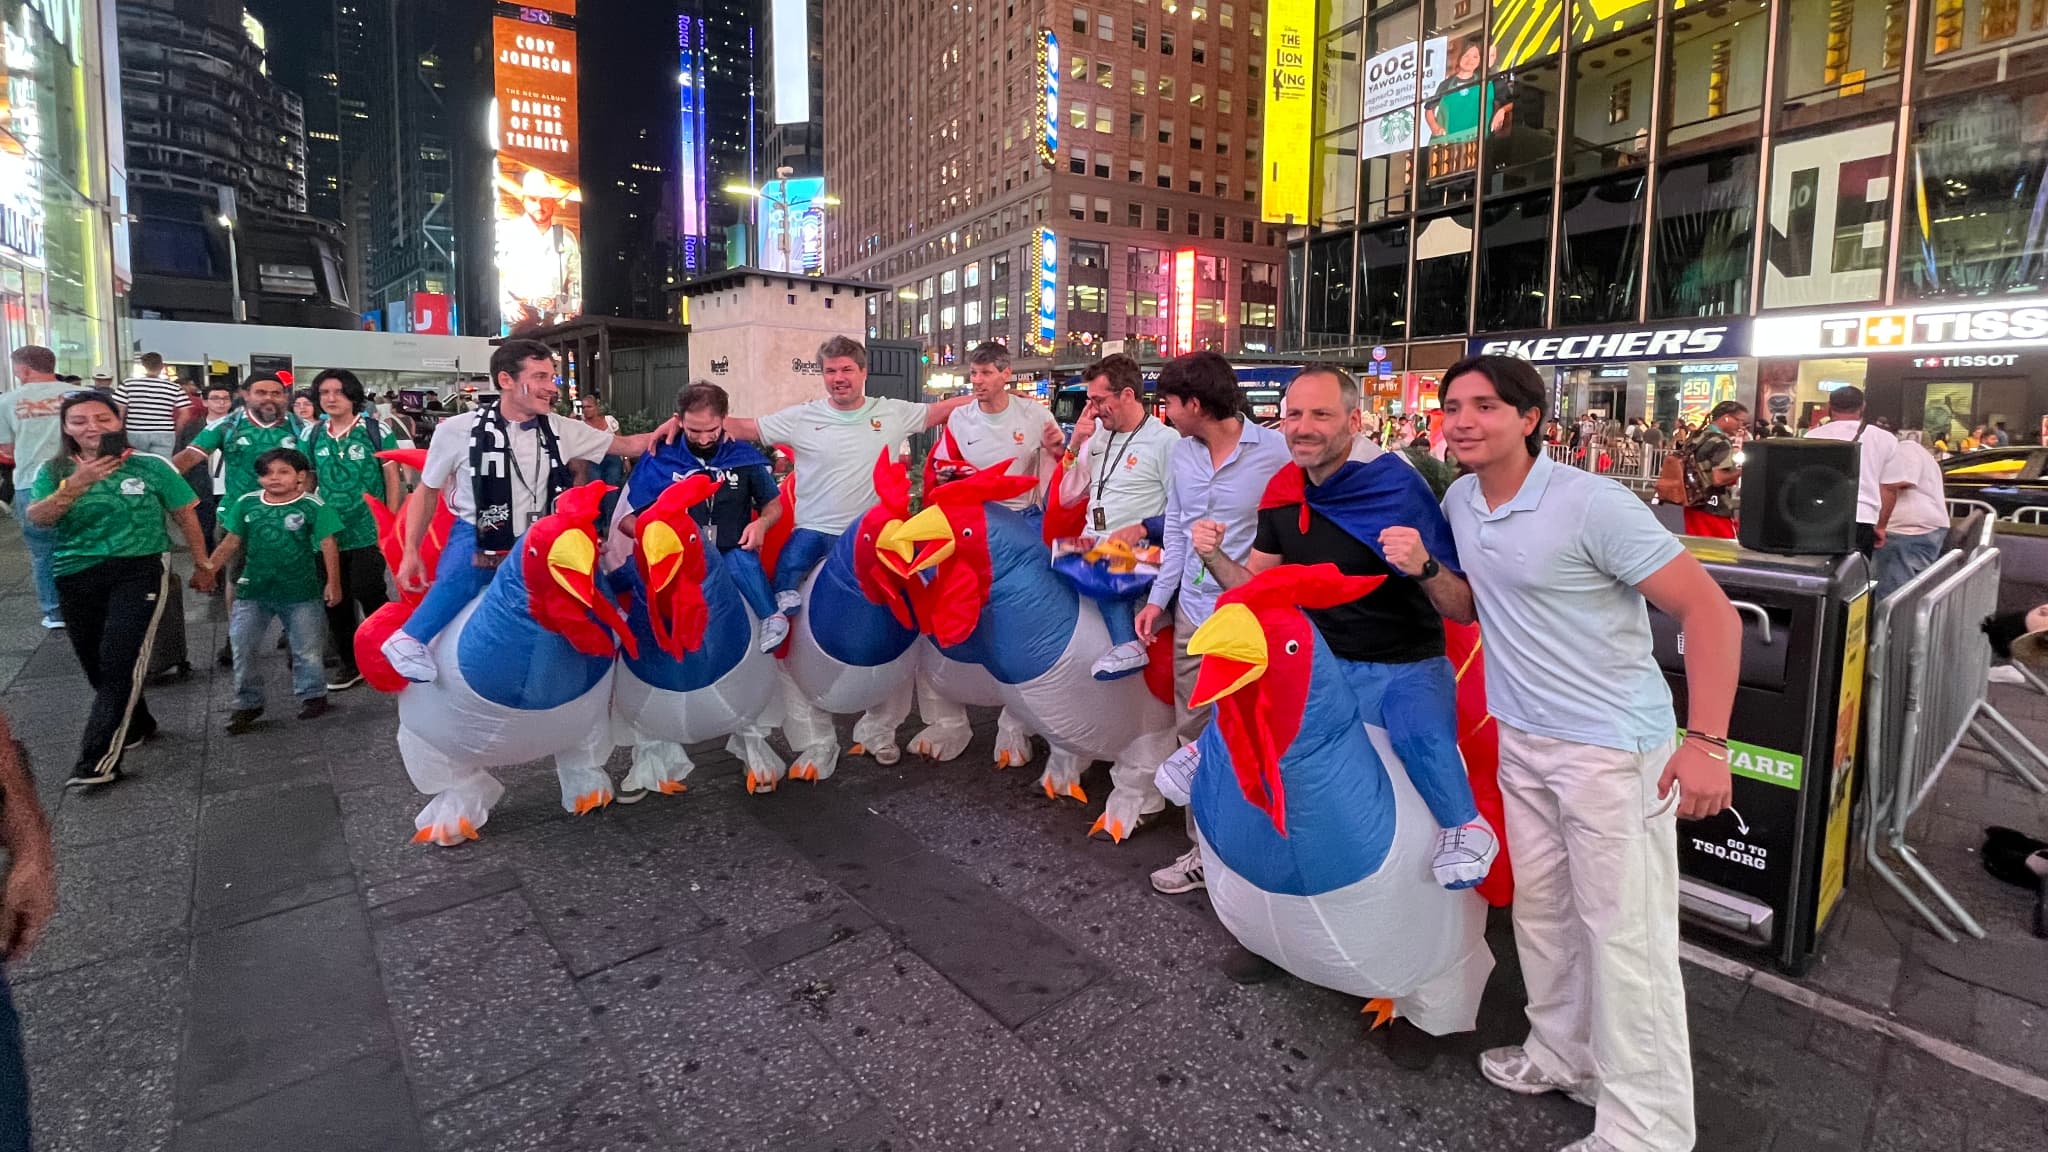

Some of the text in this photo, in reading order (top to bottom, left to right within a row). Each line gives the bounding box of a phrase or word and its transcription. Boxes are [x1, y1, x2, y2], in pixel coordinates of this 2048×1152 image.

[520, 7, 550, 25] 250
[516, 35, 555, 54] CODY
[1280, 34, 1300, 45] THE
[500, 49, 572, 75] JOHNSON
[1276, 48, 1303, 66] LION
[1273, 69, 1305, 90] KING
[506, 87, 520, 95] THE
[541, 94, 567, 102] ALBUM
[511, 98, 562, 119] BANKS
[510, 115, 563, 136] OF THE
[506, 131, 569, 153] TRINITY
[1482, 326, 1728, 361] SKECHERS
[1940, 354, 2019, 368] TISSOT
[1683, 381, 1711, 396] 250
[1692, 838, 1766, 870] TSQ.ORG
[1727, 838, 1767, 858] GO TO
